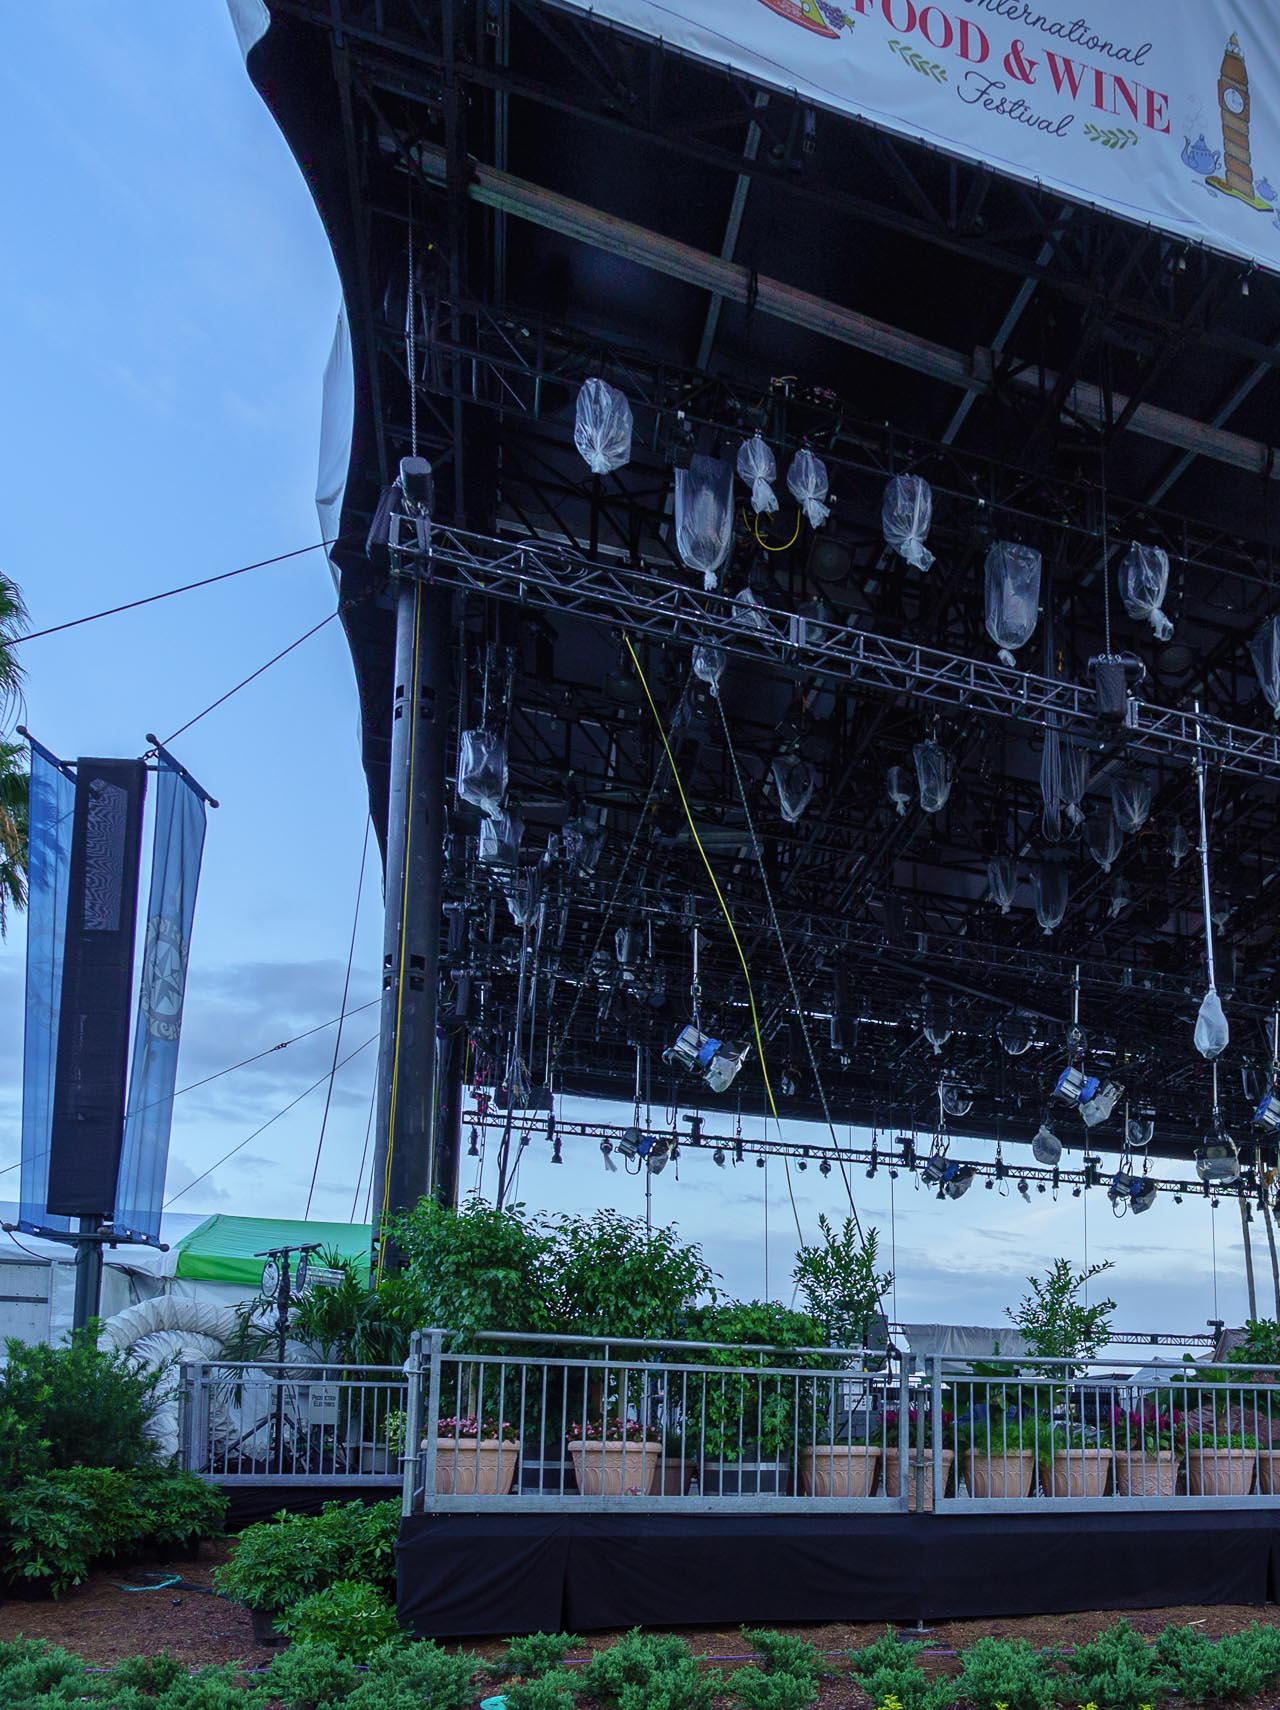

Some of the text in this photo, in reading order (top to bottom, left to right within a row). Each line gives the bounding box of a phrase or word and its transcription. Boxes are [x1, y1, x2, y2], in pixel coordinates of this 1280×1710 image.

[964, 0, 1153, 66] nternational
[957, 71, 1075, 137] Festival
[1041, 48, 1171, 134] WINE
